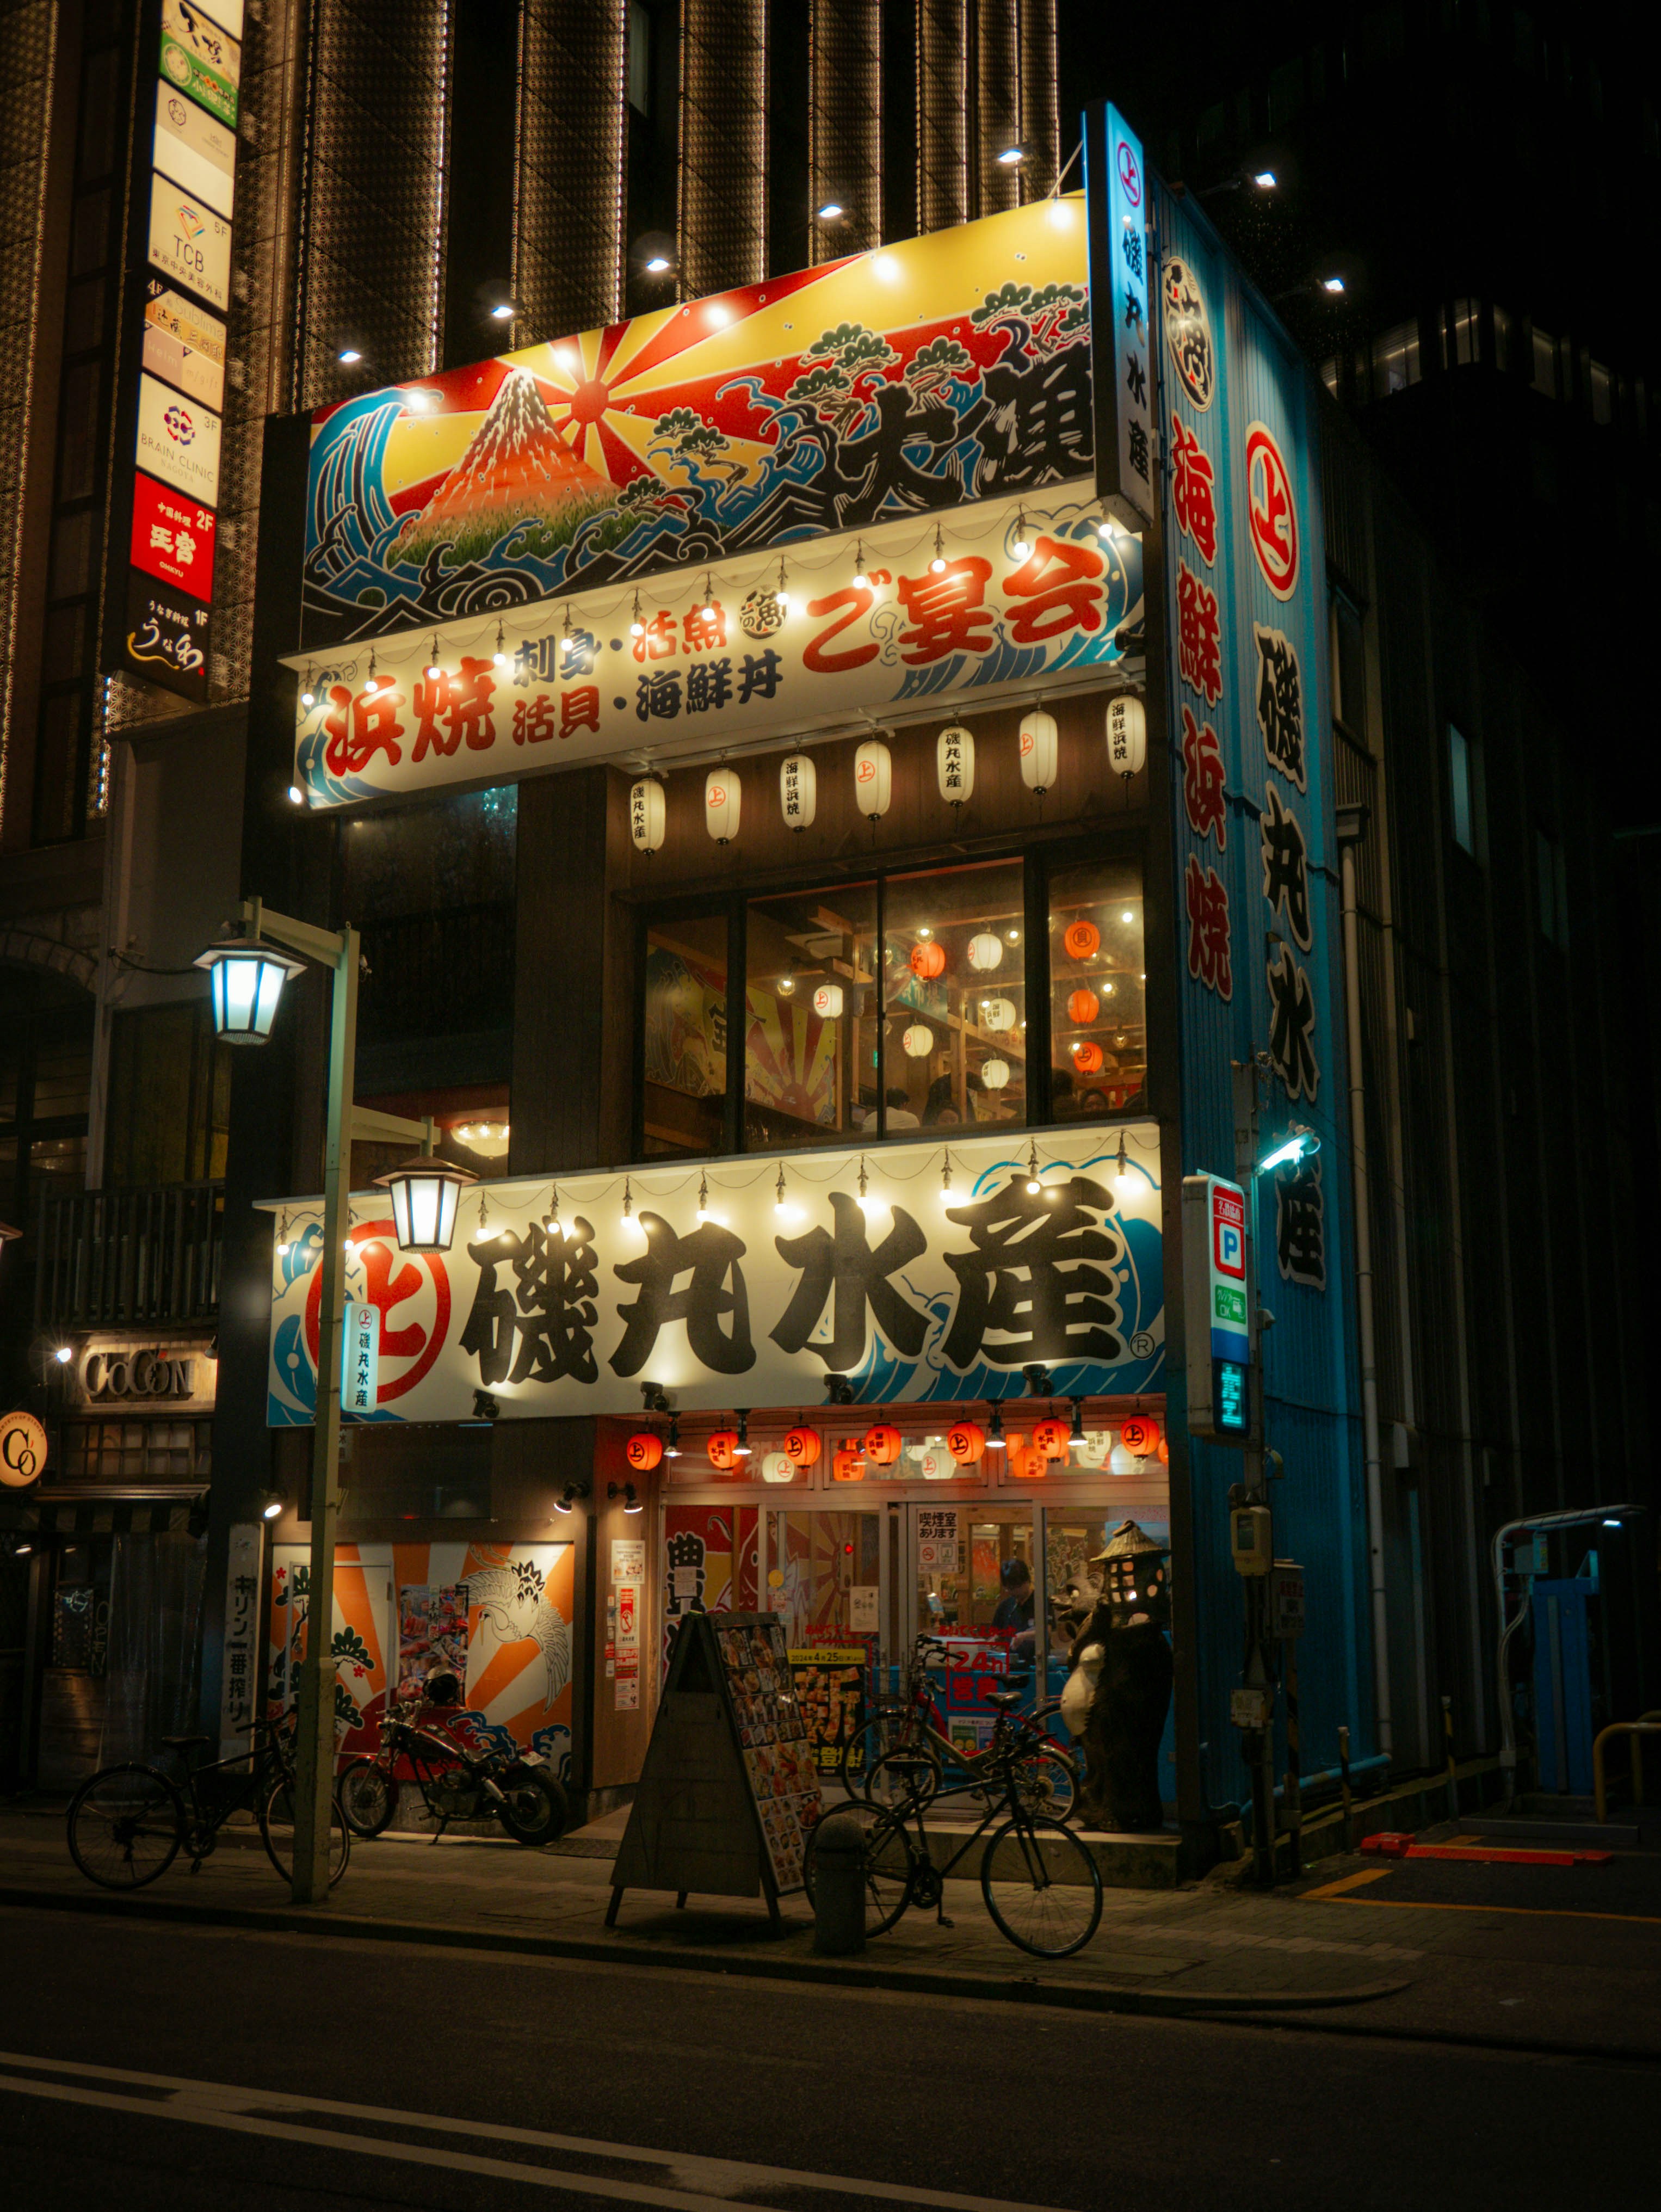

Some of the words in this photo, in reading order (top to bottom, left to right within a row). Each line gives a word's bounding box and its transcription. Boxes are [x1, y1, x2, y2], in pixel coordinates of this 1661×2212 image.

[214, 221, 227, 237] 5F
[174, 235, 204, 272] TCB
[147, 279, 164, 296] 4F
[152, 248, 222, 301] 東京中央美容外科
[204, 416, 217, 430] 3F
[140, 433, 174, 461] BRAIN
[179, 455, 214, 483] CLINIC
[161, 460, 194, 484] NAGOYA
[157, 501, 192, 528] 中国料理
[195, 510, 214, 532] 2F
[150, 522, 196, 565] 王宮
[148, 599, 189, 627] うなぎ料理
[194, 609, 208, 627] 1F
[803, 535, 1107, 674] ご宴会
[325, 655, 496, 777] 浜焼
[1172, 411, 1231, 999] 海鮮浜焼
[1112, 703, 1128, 760] 海鮮浜焼
[944, 732, 962, 788] 磯丸水産
[786, 762, 800, 816] 海鮮浜焼
[633, 786, 646, 839] 磯丸水産
[1223, 1229, 1238, 1261] P
[460, 1175, 1121, 1385] 磯丸水産
[1220, 1304, 1231, 1318] OK
[355, 1333, 371, 1407] 磯丸水産
[919, 1511, 957, 1527] 喫煙室
[919, 1528, 957, 1539] あります
[228, 1575, 251, 1723] キリン一番搾り
[953, 1676, 1000, 1702] 営業
